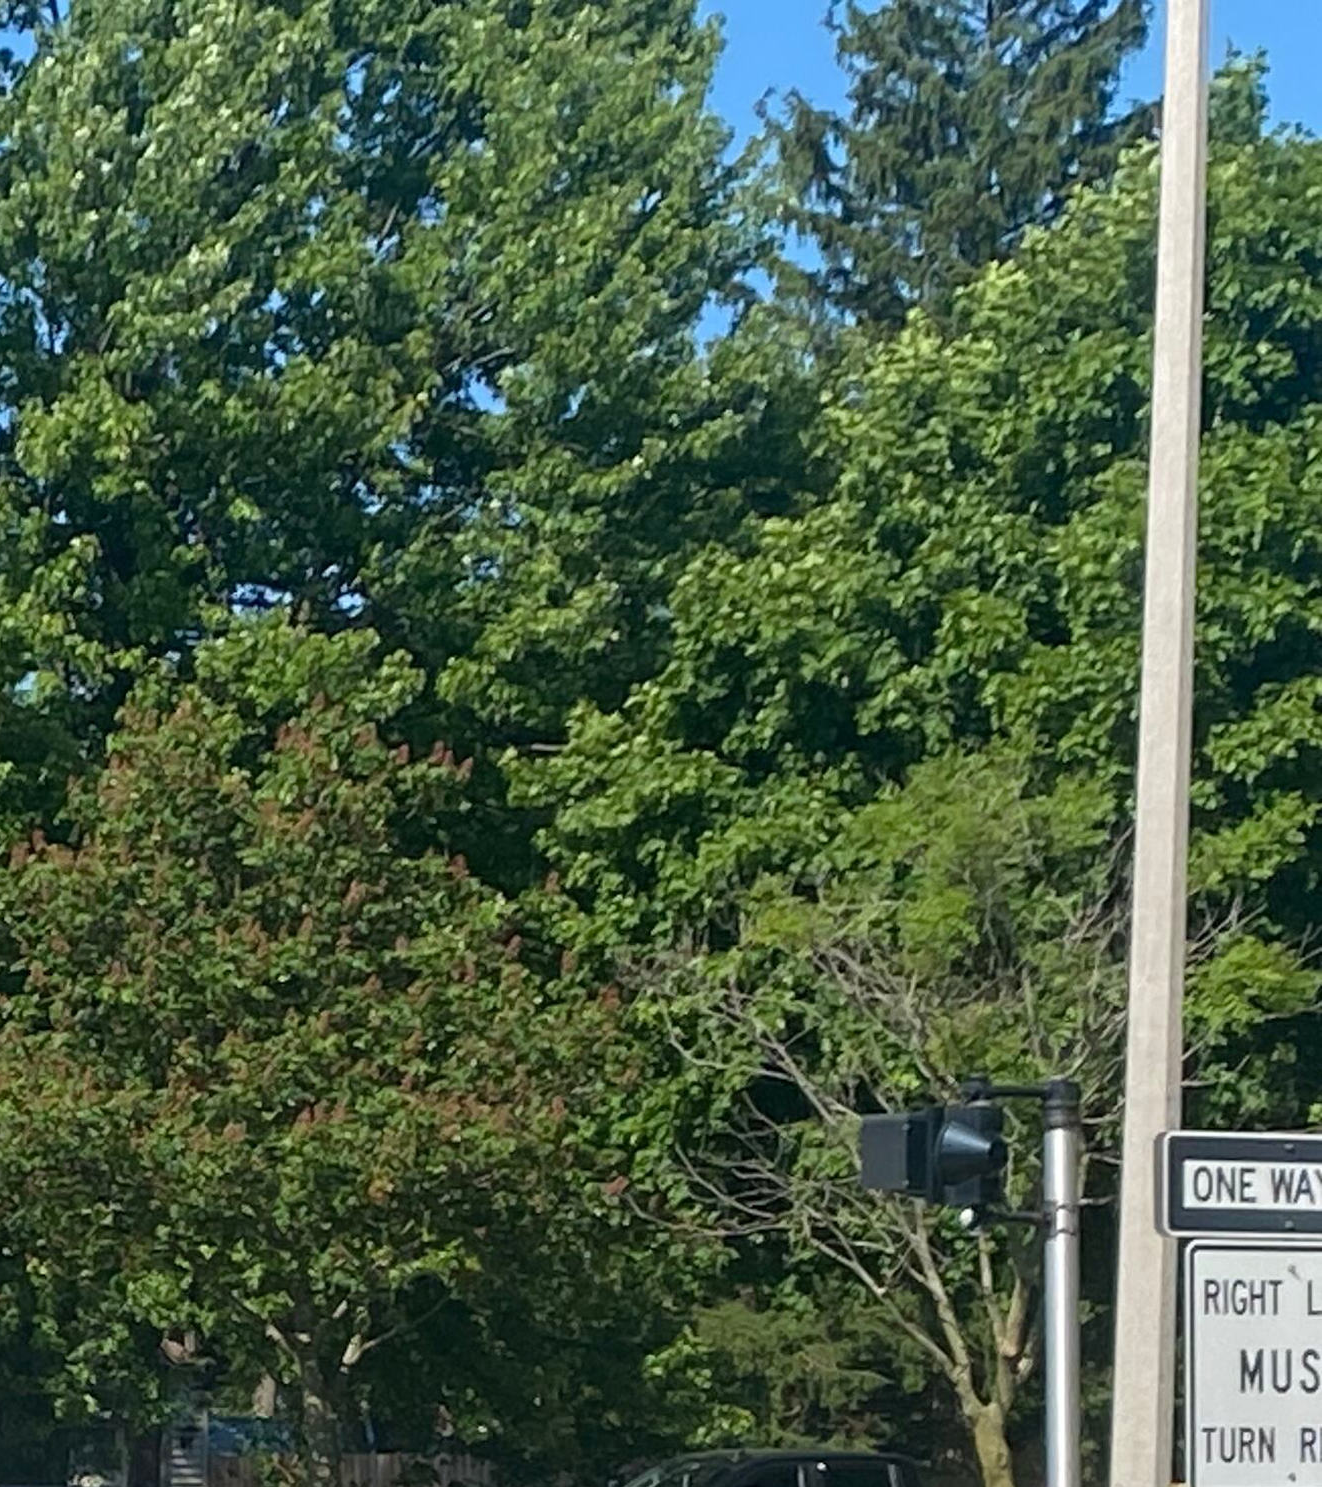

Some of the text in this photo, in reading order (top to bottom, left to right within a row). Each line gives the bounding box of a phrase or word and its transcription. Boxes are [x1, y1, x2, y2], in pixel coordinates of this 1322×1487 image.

[1193, 1166, 1257, 1203] ONE
[1203, 1279, 1283, 1316] RIGHT
[1201, 1426, 1276, 1464] TURN
